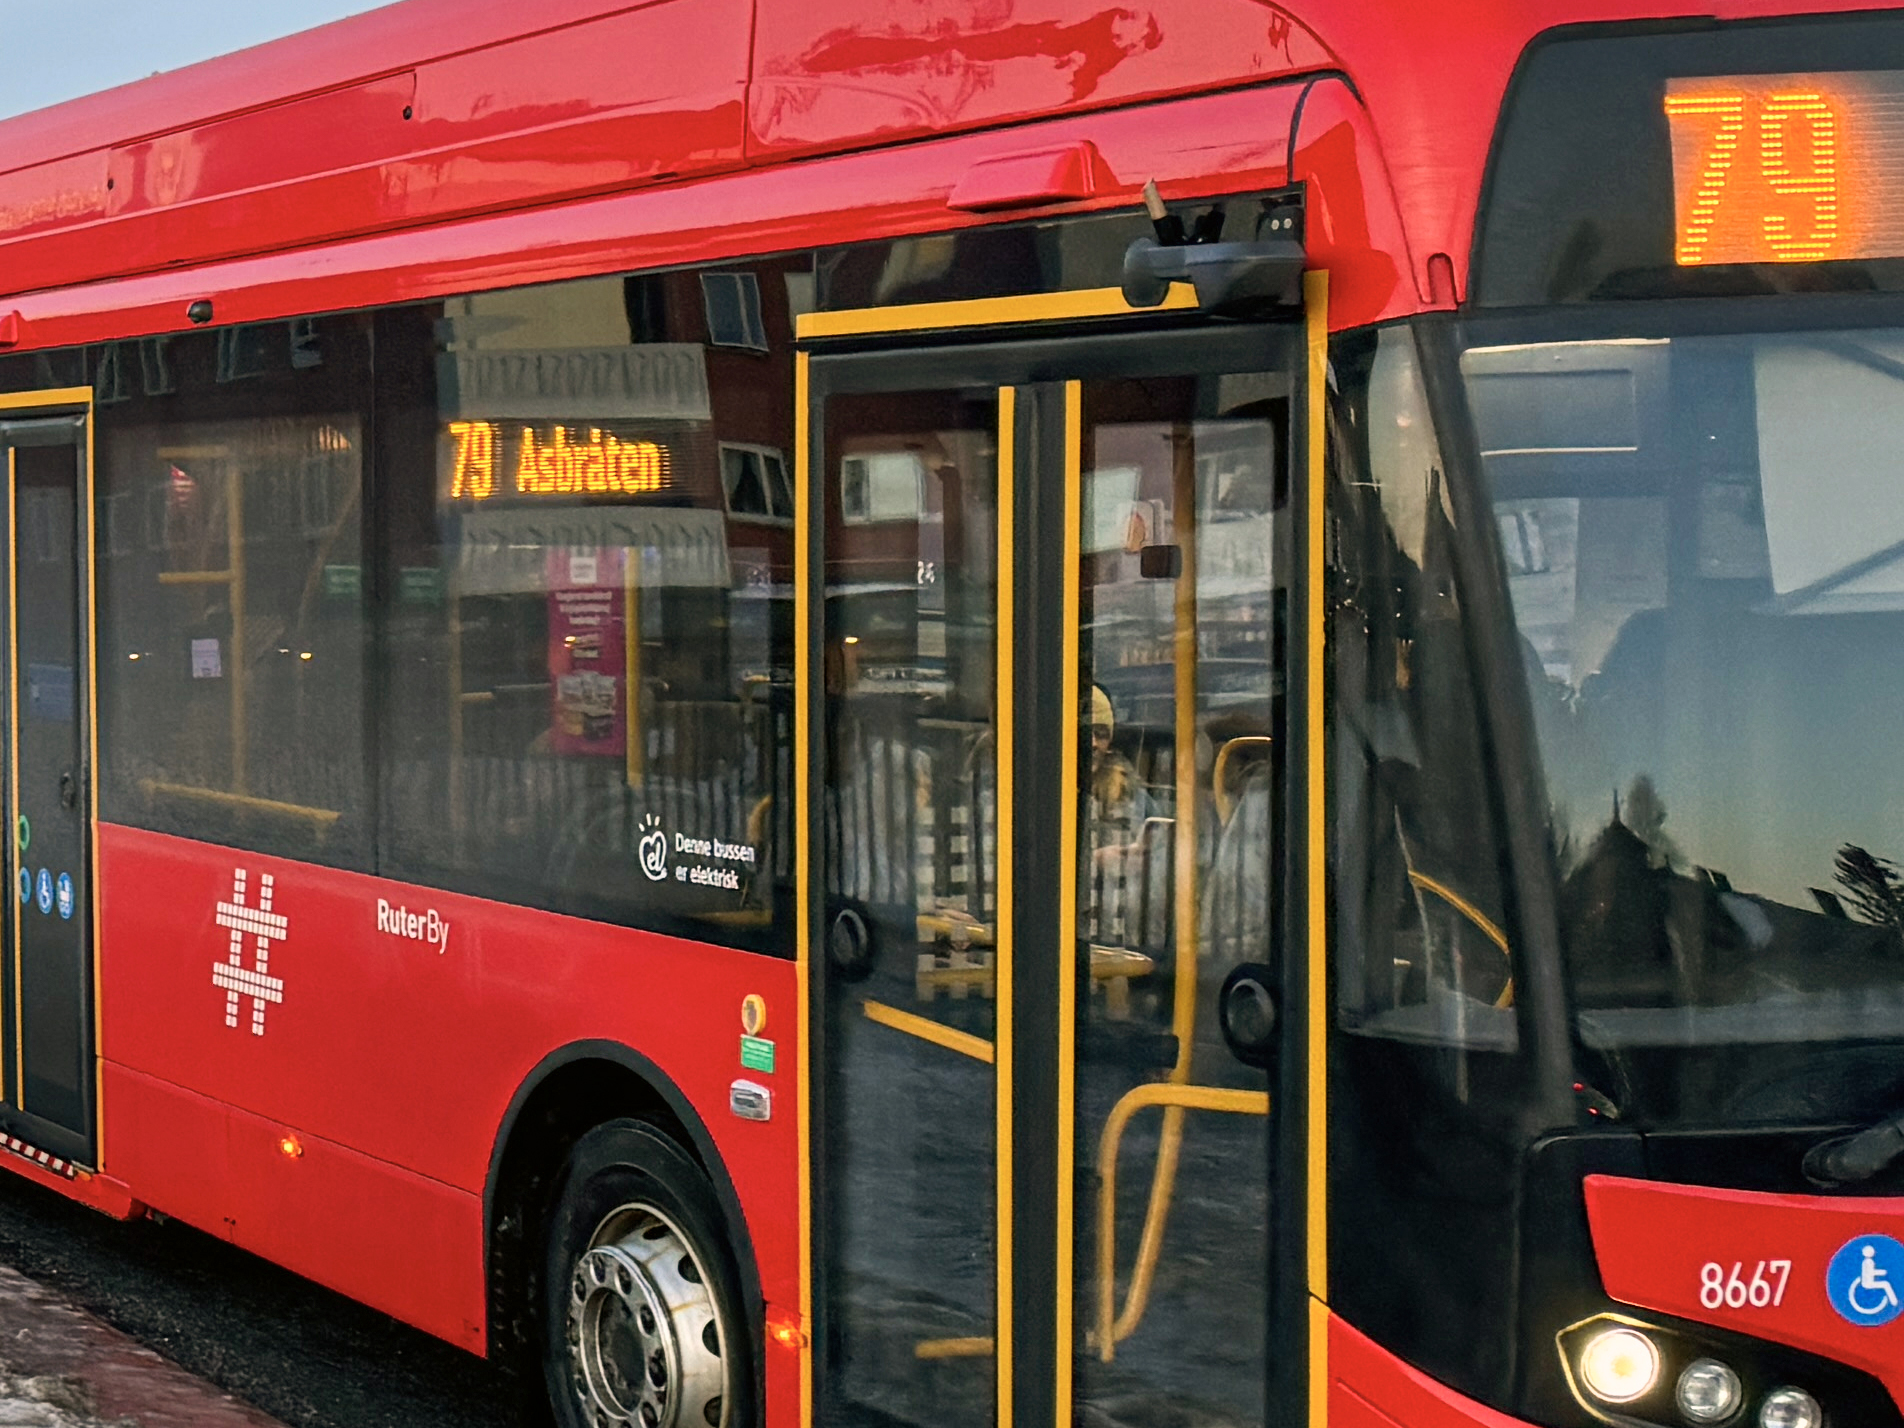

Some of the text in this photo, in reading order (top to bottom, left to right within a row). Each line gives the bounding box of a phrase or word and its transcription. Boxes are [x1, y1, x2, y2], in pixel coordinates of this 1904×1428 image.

[1666, 94, 1838, 262] 79
[449, 422, 493, 498] 79
[675, 832, 755, 863] Denne bussen
[675, 864, 740, 890] er elektrisk
[377, 898, 450, 955] RuterBy
[1700, 1259, 1792, 1309] 8667
